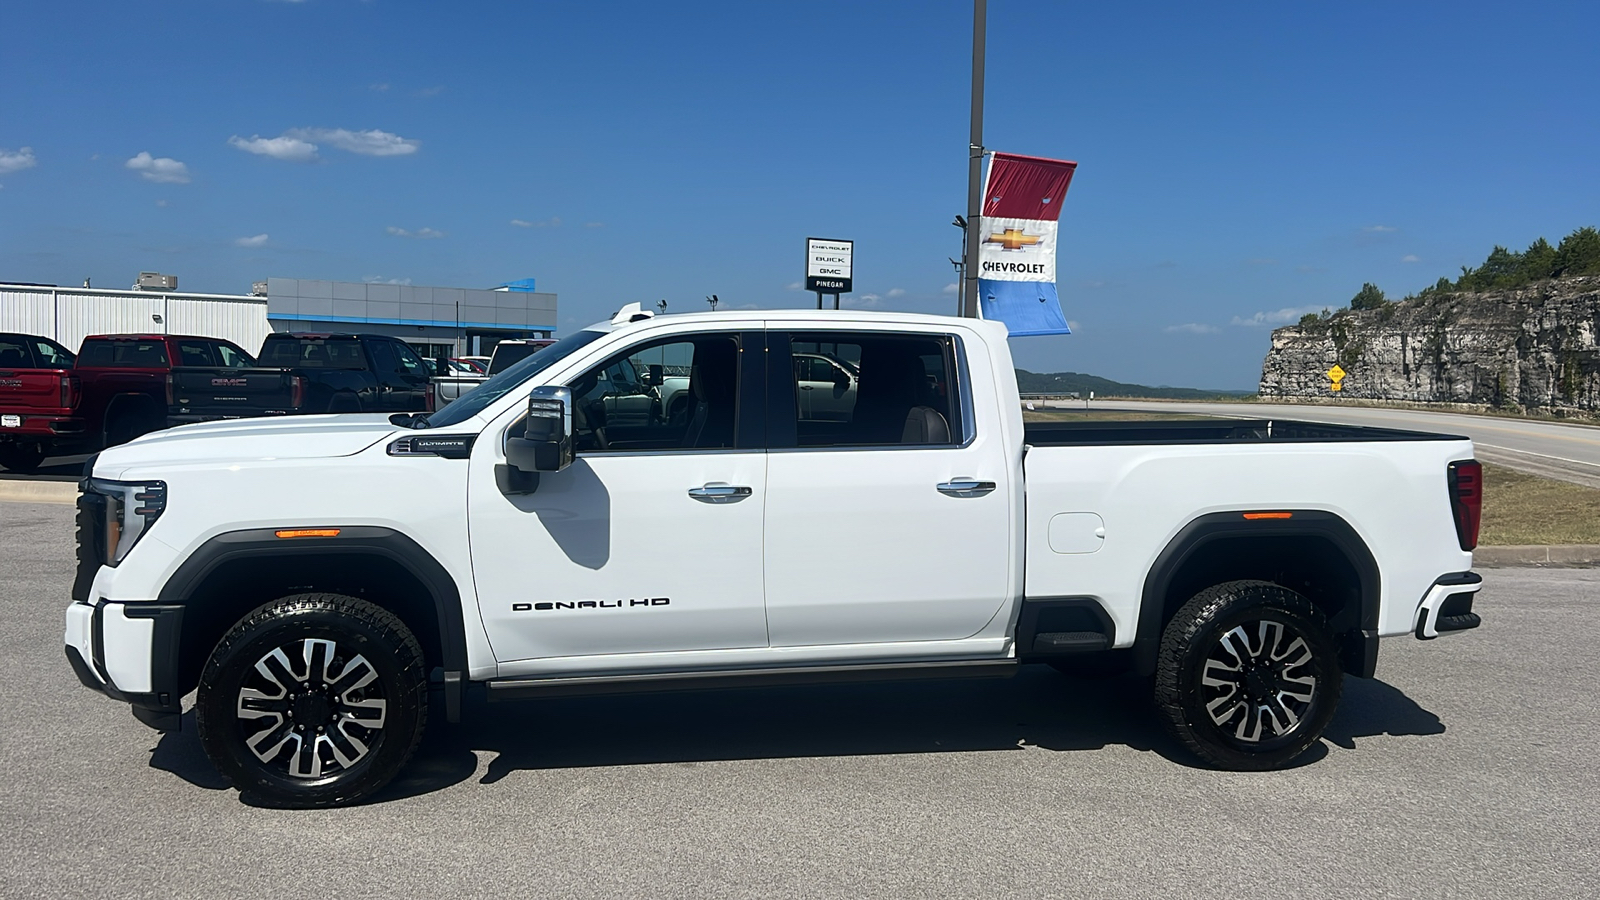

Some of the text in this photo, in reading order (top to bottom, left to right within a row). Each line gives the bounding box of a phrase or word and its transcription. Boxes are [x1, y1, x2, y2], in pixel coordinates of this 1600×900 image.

[982, 261, 1045, 274] CHEVROLET
[816, 280, 844, 288] PINEGAR
[211, 378, 247, 386] GMC
[512, 598, 670, 611] DENALI HD
